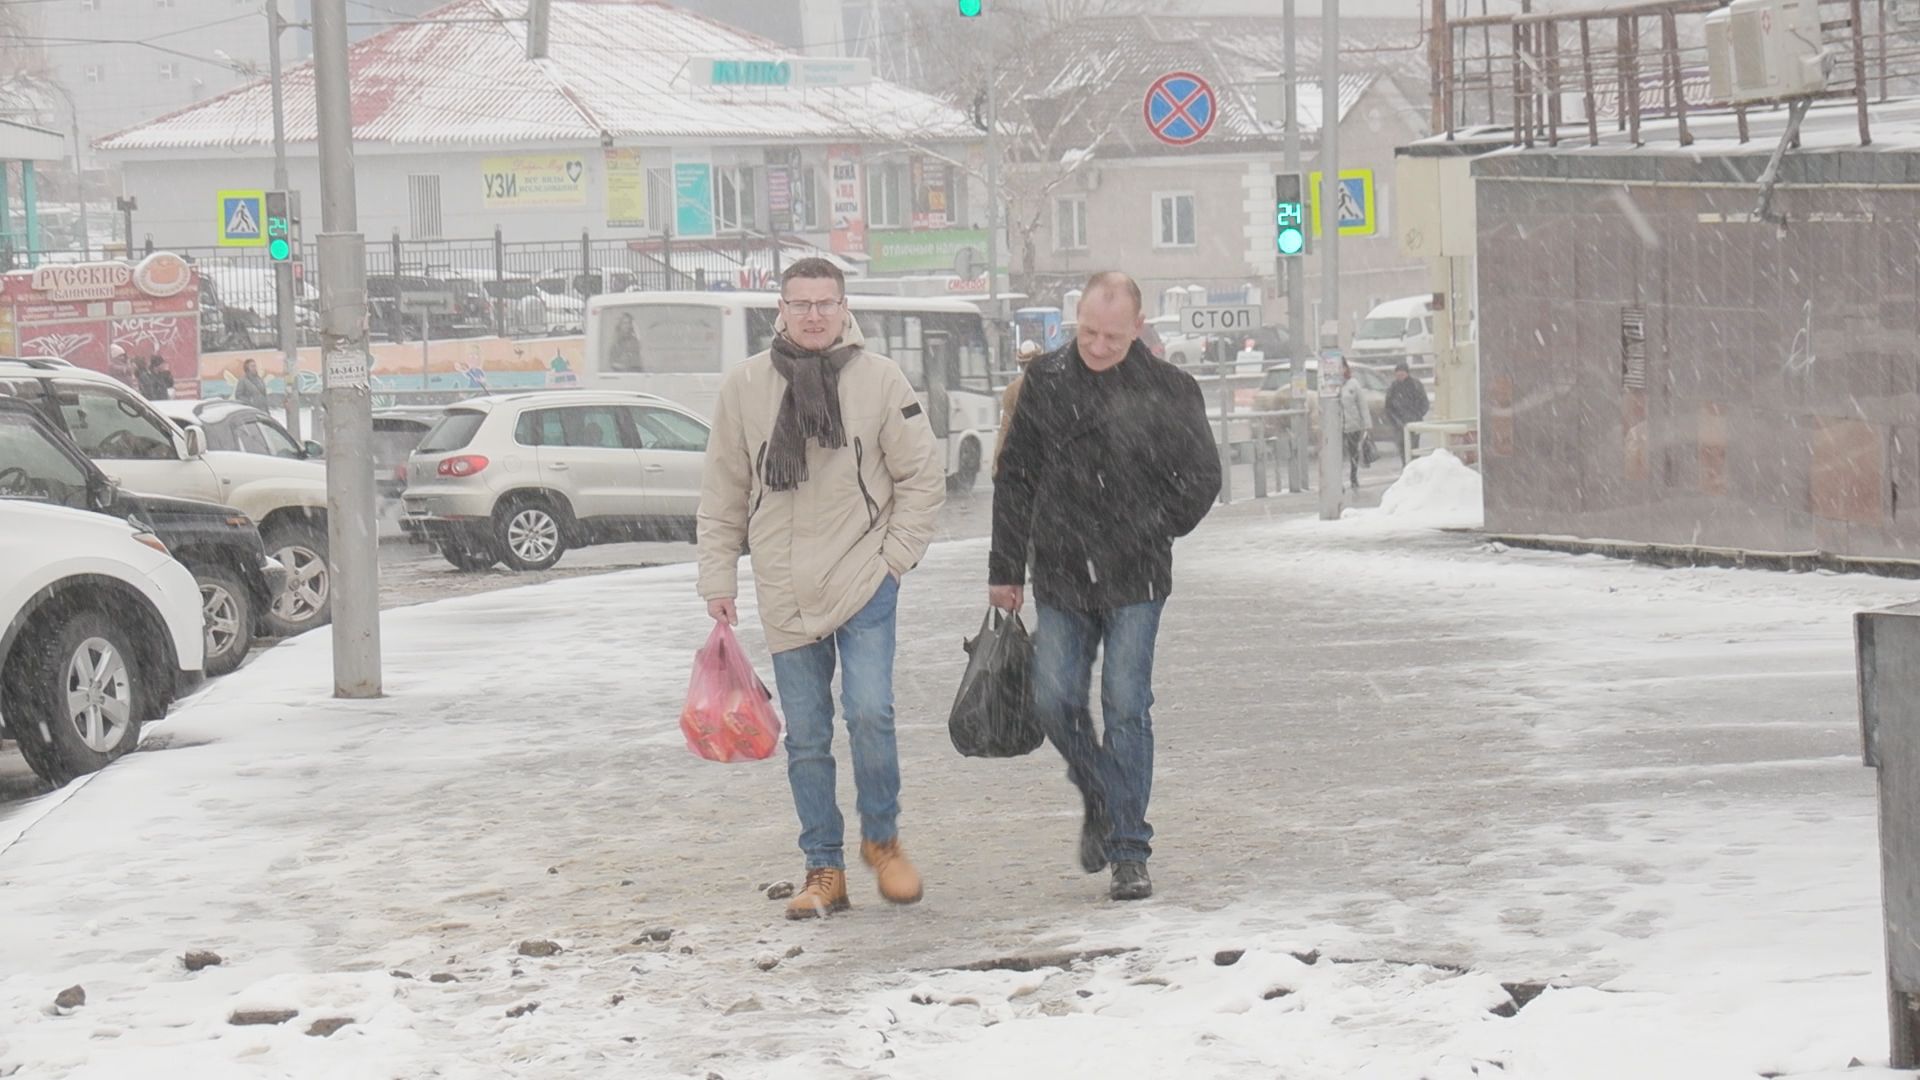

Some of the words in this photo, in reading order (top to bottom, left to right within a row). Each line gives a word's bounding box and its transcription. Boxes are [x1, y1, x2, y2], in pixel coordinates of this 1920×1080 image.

[484, 173, 518, 199] УЗИ
[269, 216, 288, 236] 24
[1278, 203, 1301, 226] 24
[40, 265, 128, 289] РУССКИЕ
[1191, 310, 1250, 328] СТОП
